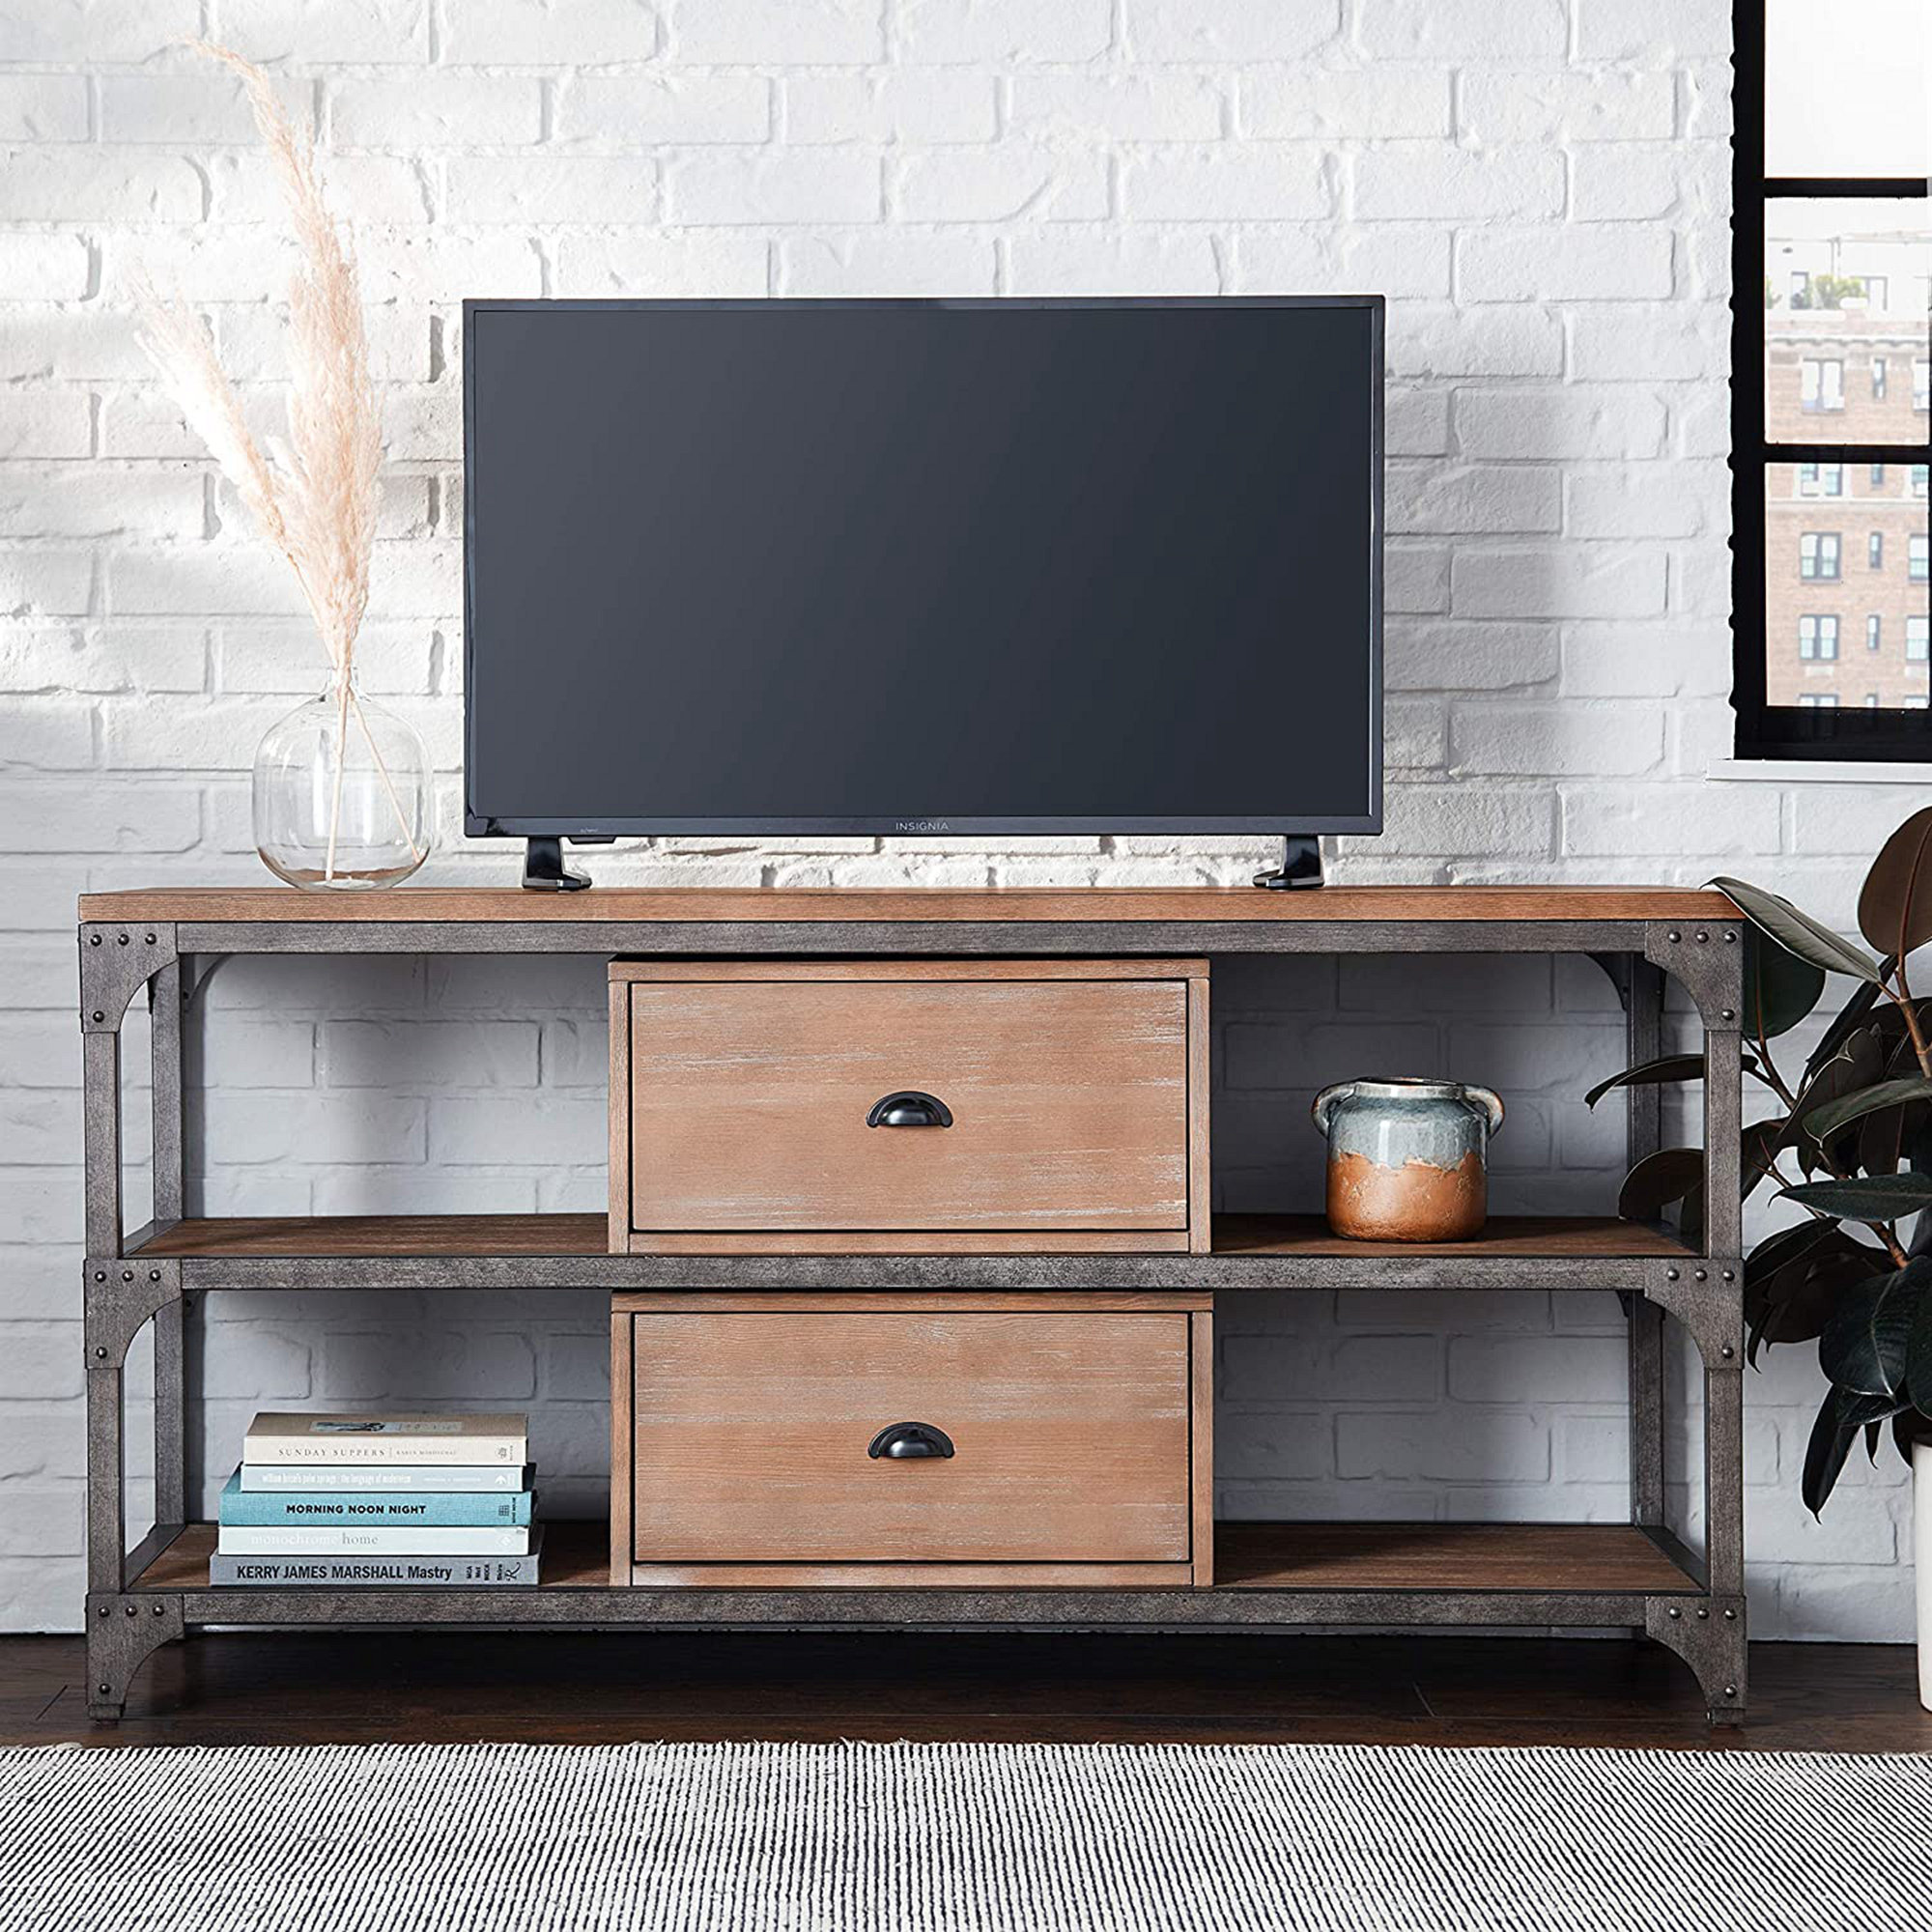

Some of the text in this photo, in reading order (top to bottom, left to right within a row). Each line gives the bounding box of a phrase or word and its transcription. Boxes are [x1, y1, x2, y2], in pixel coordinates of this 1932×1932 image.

[895, 821, 950, 831] INSIGNIA
[286, 1505, 427, 1515] MORNING NOON NIGHT
[250, 1532, 379, 1546] monochrome home
[237, 1565, 453, 1581] KERRY JAMES MARSHALL Mastry
